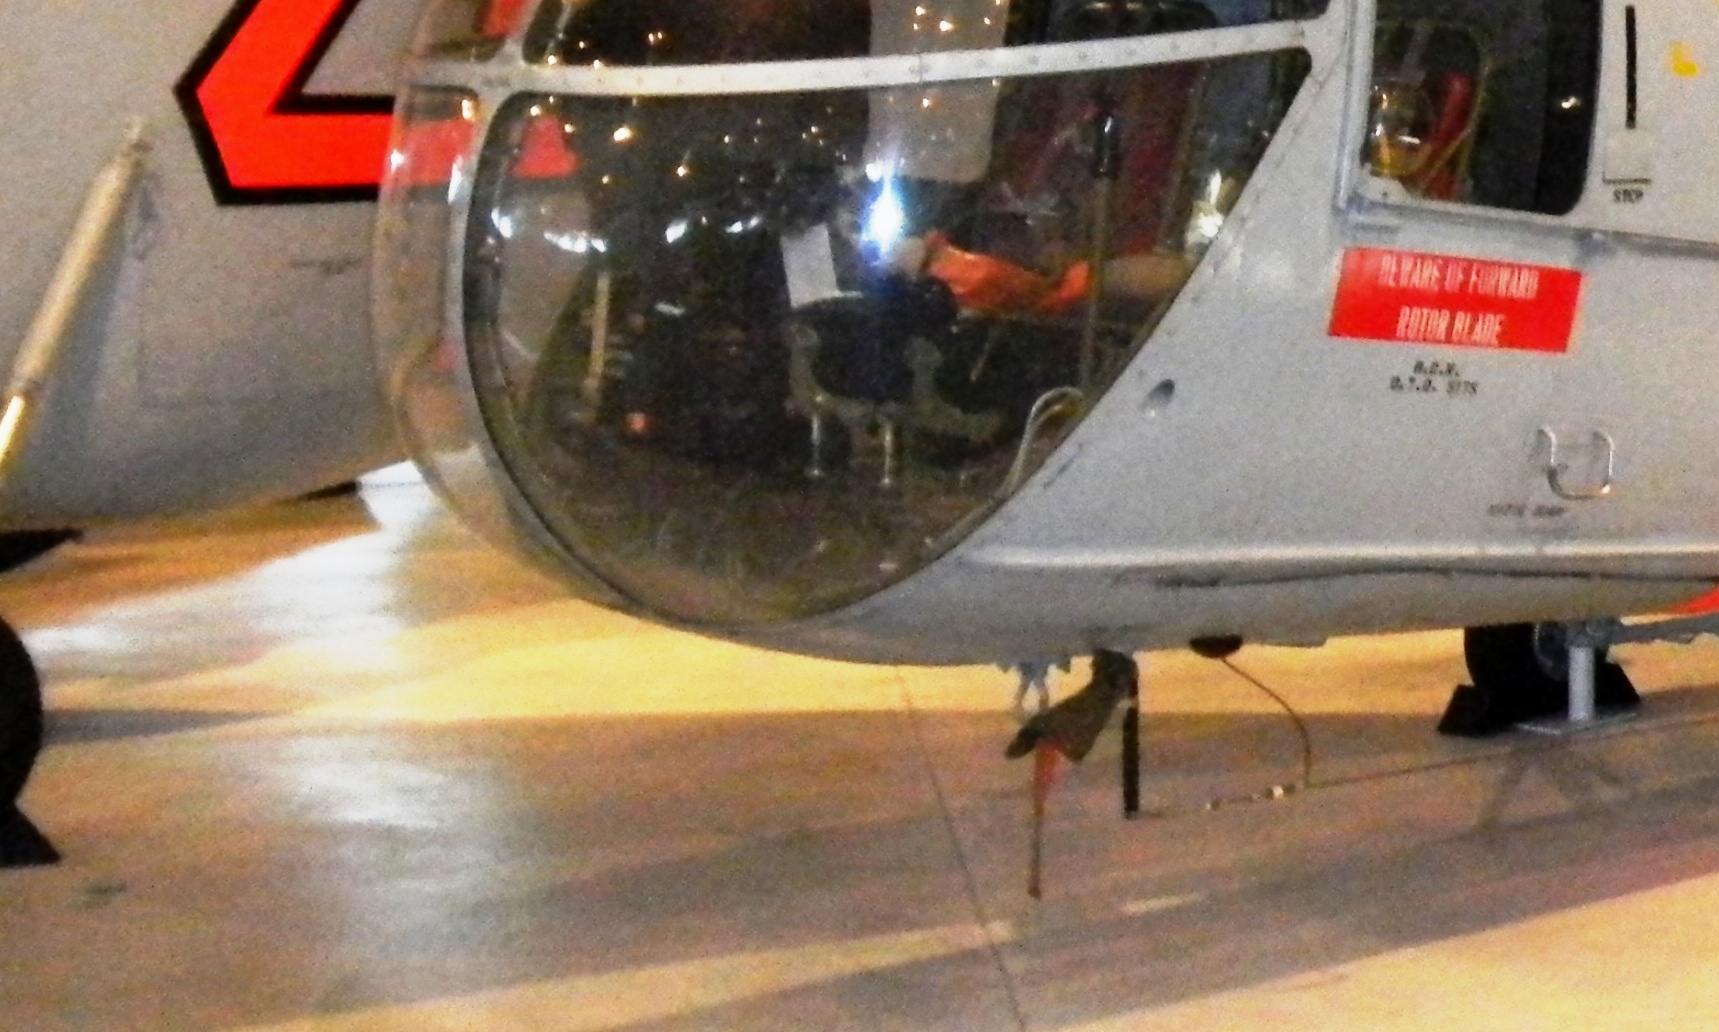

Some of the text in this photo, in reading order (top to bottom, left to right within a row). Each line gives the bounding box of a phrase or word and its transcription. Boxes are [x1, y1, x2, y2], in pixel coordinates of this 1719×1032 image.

[1378, 253, 1541, 300] BEWARE OF FORWARD
[1396, 305, 1507, 347] ROTOR BLADE
